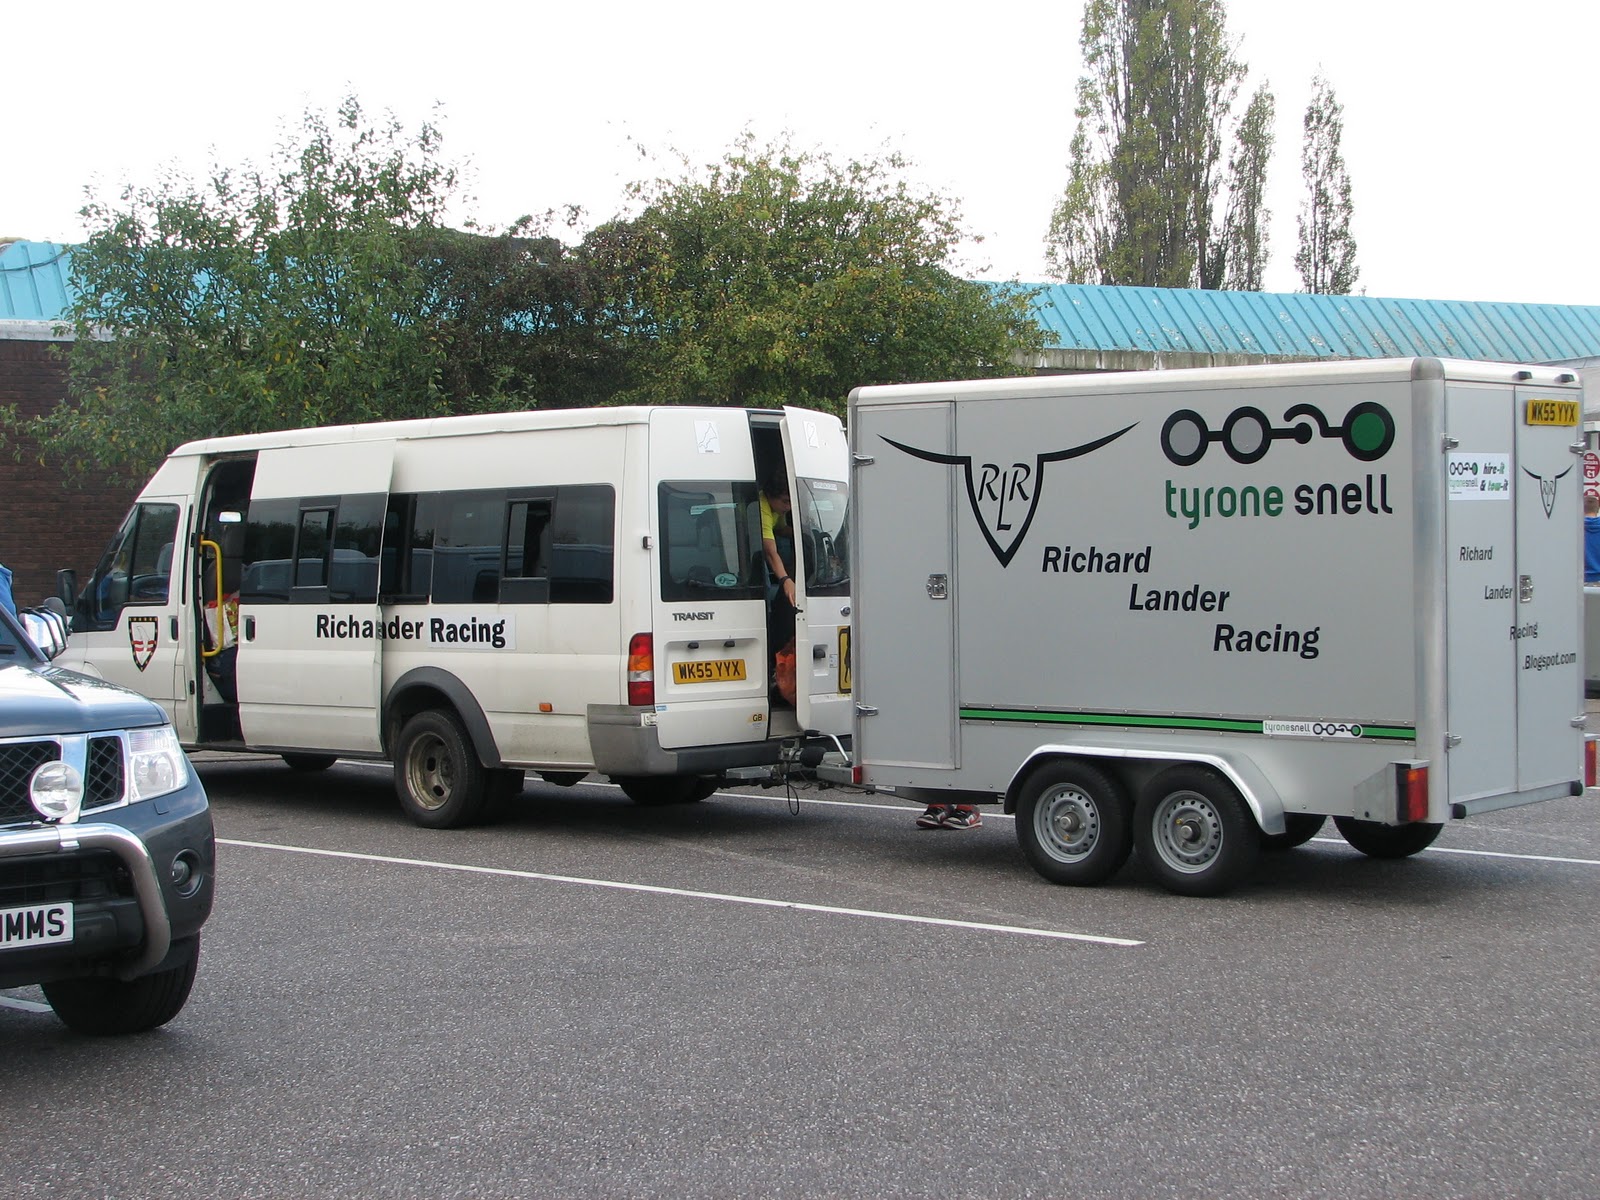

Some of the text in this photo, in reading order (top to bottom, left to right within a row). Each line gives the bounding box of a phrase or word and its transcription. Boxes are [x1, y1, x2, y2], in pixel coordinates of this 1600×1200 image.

[1531, 402, 1575, 423] WK55 YYX
[1165, 474, 1393, 530] tyrone snell
[1042, 546, 1152, 573] Richard
[1460, 546, 1493, 561] Richard
[1129, 583, 1230, 612] Lander
[1484, 585, 1513, 600] Lander
[672, 611, 715, 621] TRANSIT
[430, 616, 506, 649] Racing
[1213, 623, 1320, 659] Racing
[1510, 622, 1538, 640] Racing
[678, 660, 741, 680] WK55 YYX
[752, 713, 763, 722] GB
